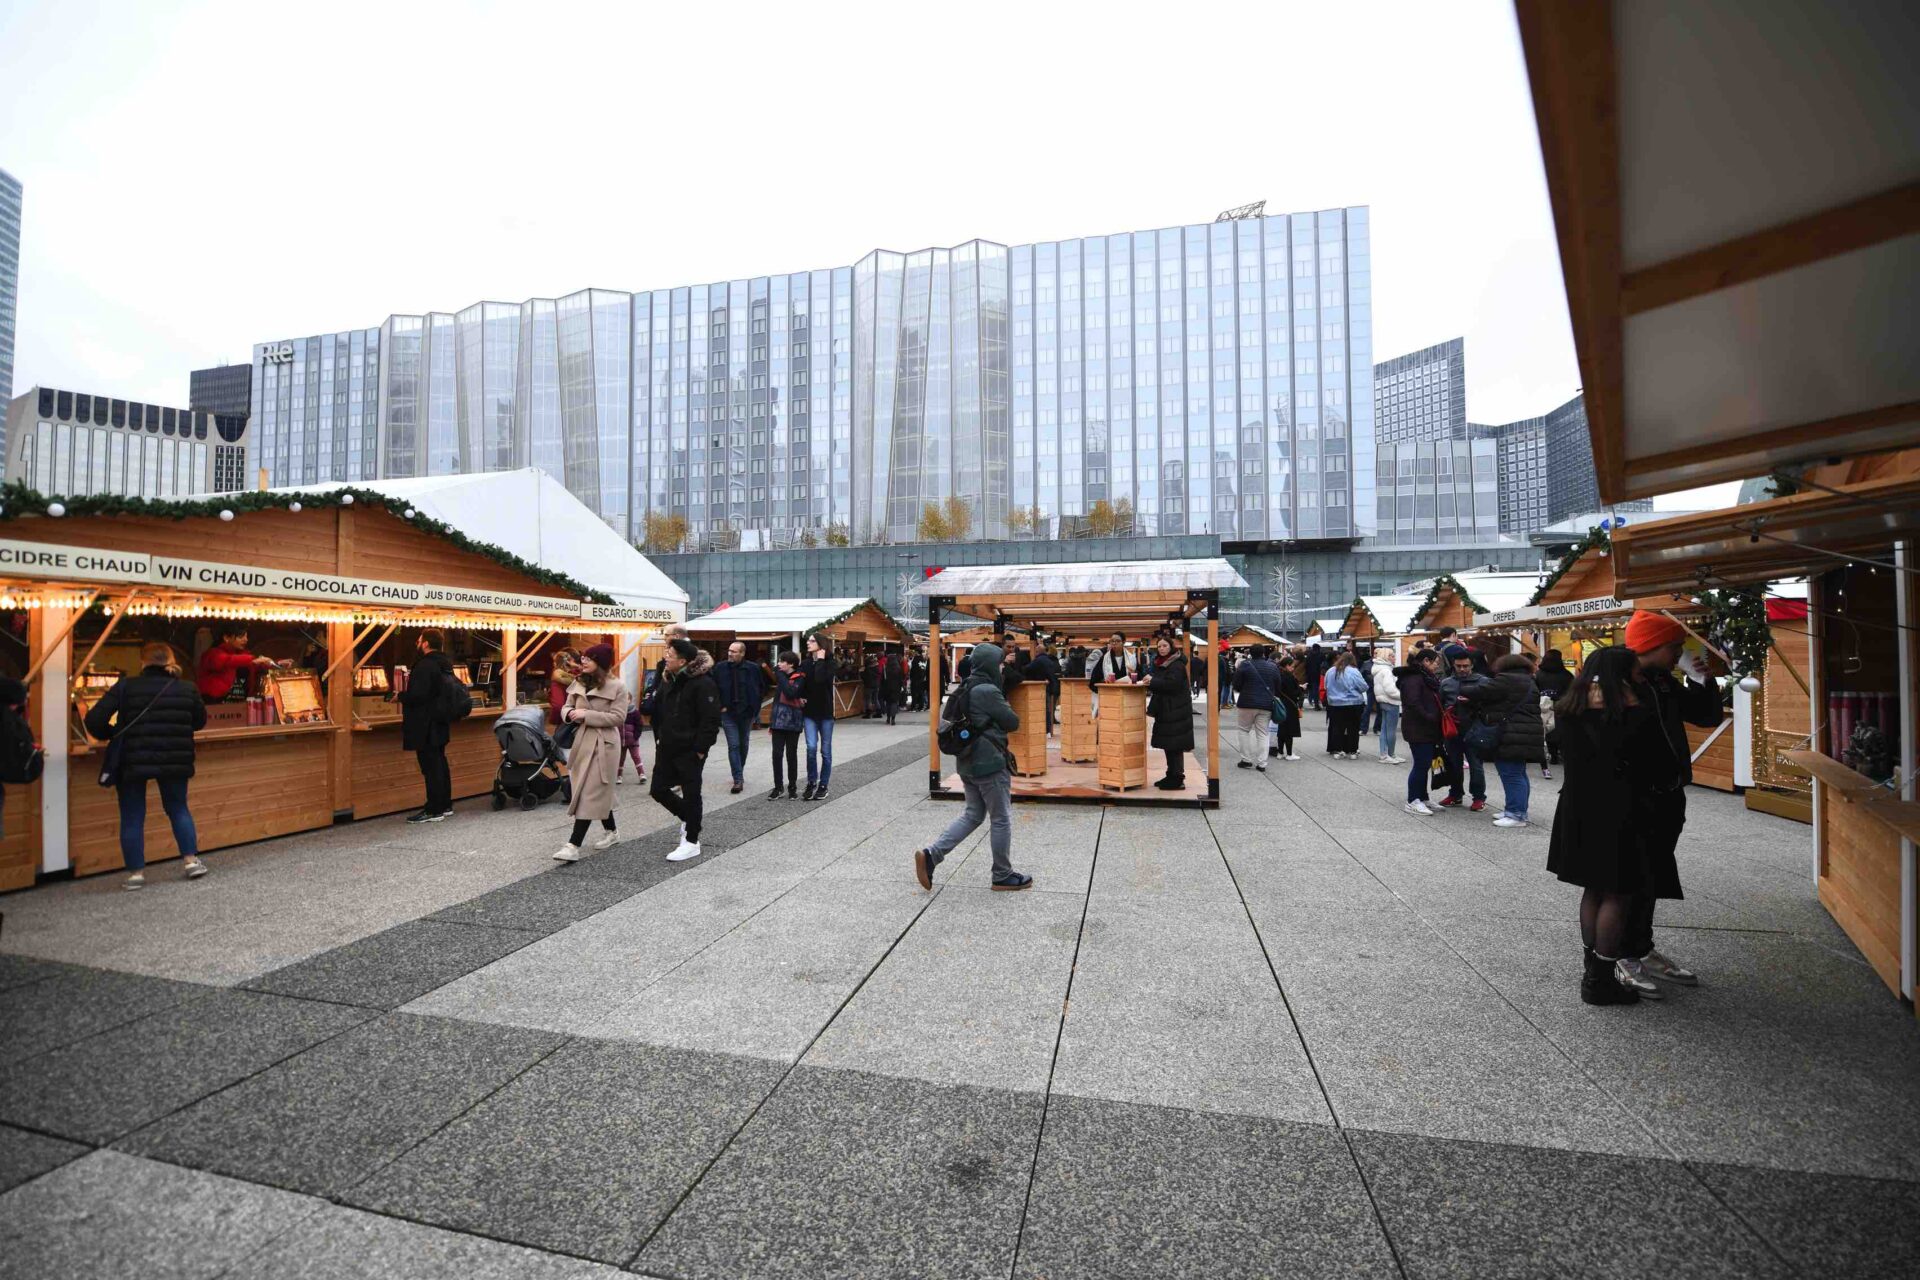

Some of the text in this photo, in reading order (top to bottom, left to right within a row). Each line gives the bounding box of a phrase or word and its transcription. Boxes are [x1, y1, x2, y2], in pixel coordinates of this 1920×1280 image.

[0, 548, 147, 574] CIDRE CHAUD
[158, 564, 192, 581] VIN
[199, 568, 266, 587] CHAUD
[282, 576, 368, 596] CHOCOLAT
[371, 585, 419, 600] CHAUD
[424, 590, 444, 600] JUS
[446, 592, 493, 605] D'ORANGE
[494, 596, 522, 607] CHAUD
[528, 600, 553, 610] PUNCH
[554, 602, 579, 612] CHAUD
[1546, 598, 1622, 617] PRODUITS BRETONS
[592, 607, 637, 619] ESCARGOT
[643, 609, 671, 620] SOUPES
[1493, 611, 1516, 623] CREPES
